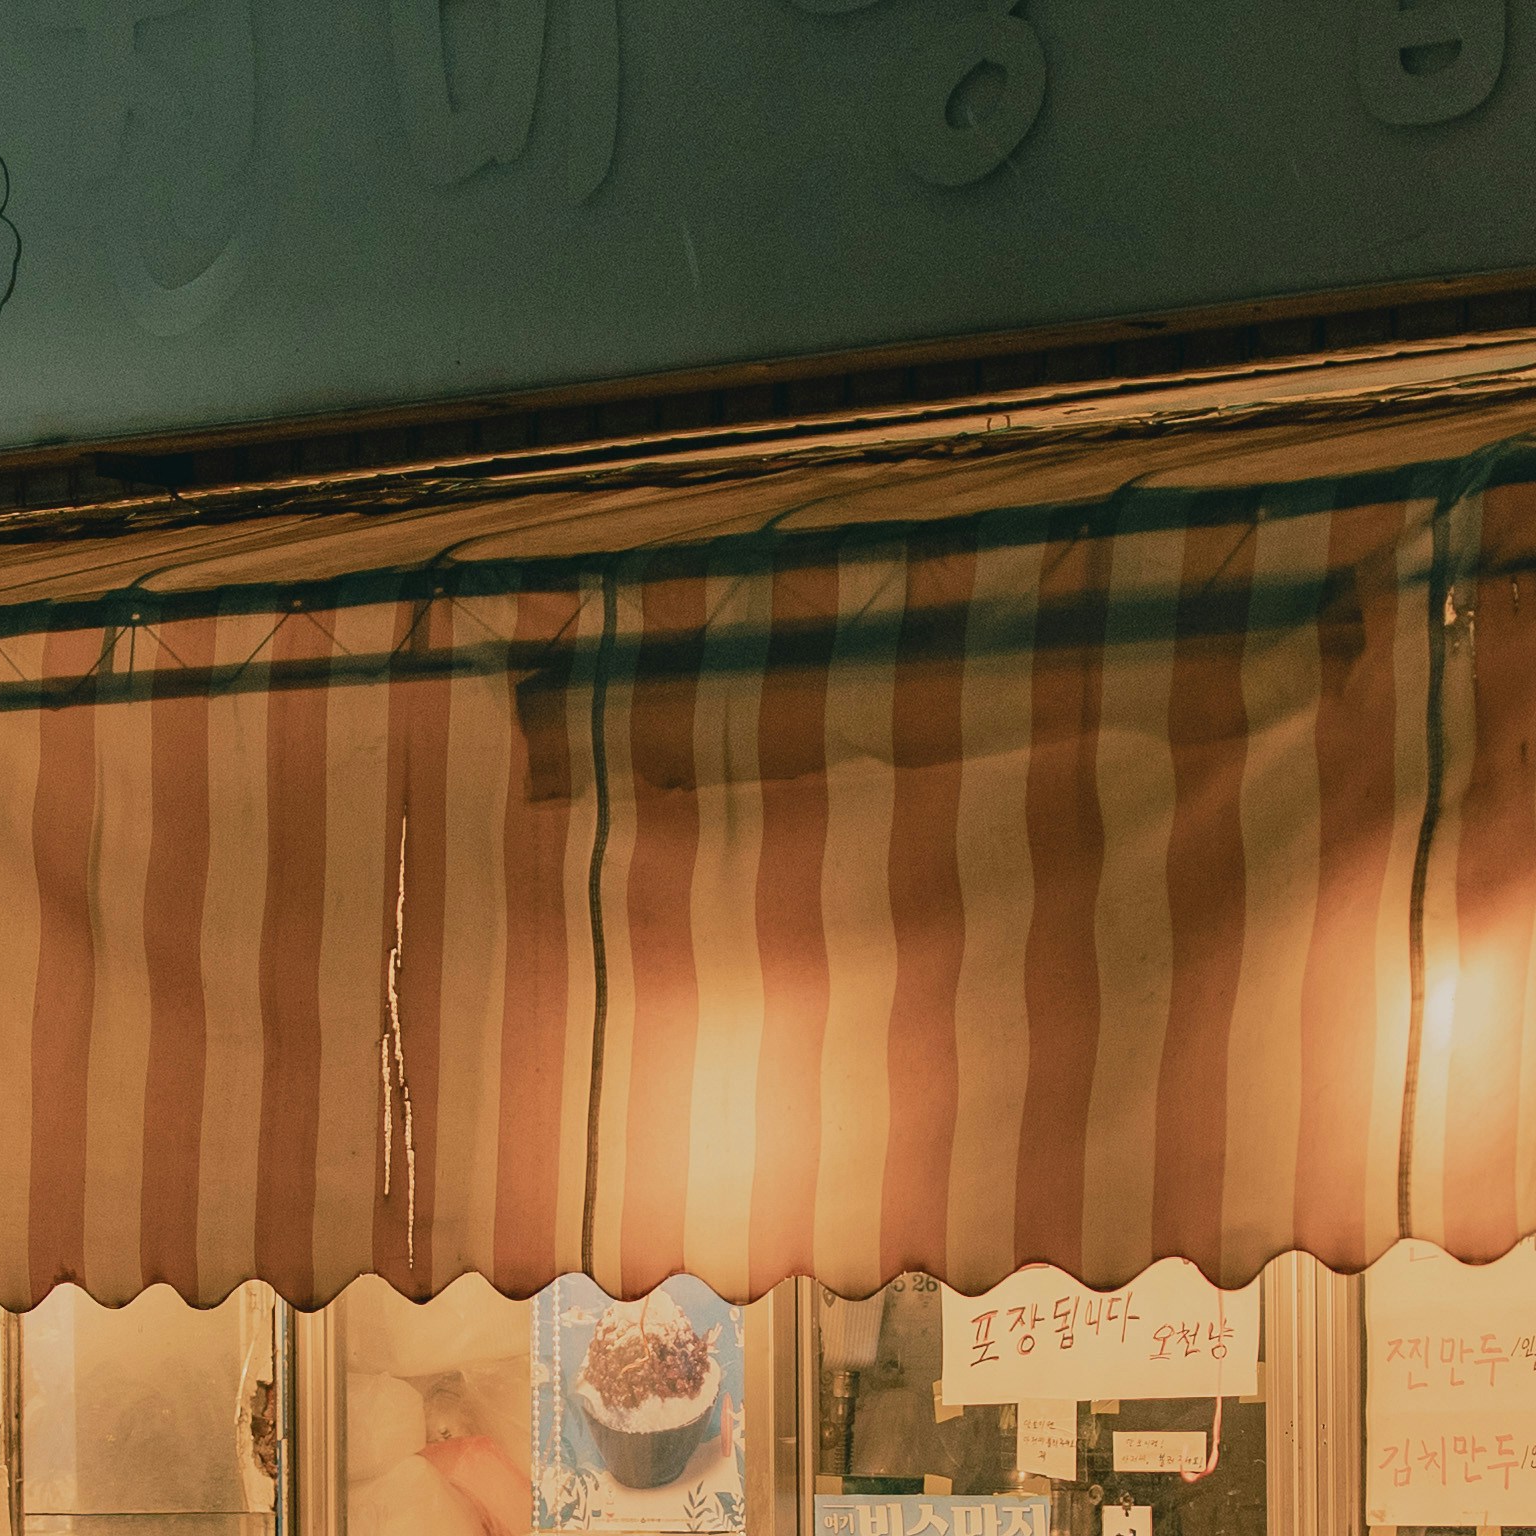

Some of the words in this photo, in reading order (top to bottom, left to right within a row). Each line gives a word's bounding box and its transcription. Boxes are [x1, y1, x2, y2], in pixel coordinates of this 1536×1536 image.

[970, 1291, 1140, 1368] 포장됩니다
[1387, 1333, 1510, 1390] 찐만두
[1379, 1434, 1520, 1490] 김치만두
[824, 1512, 855, 1534] 여기
